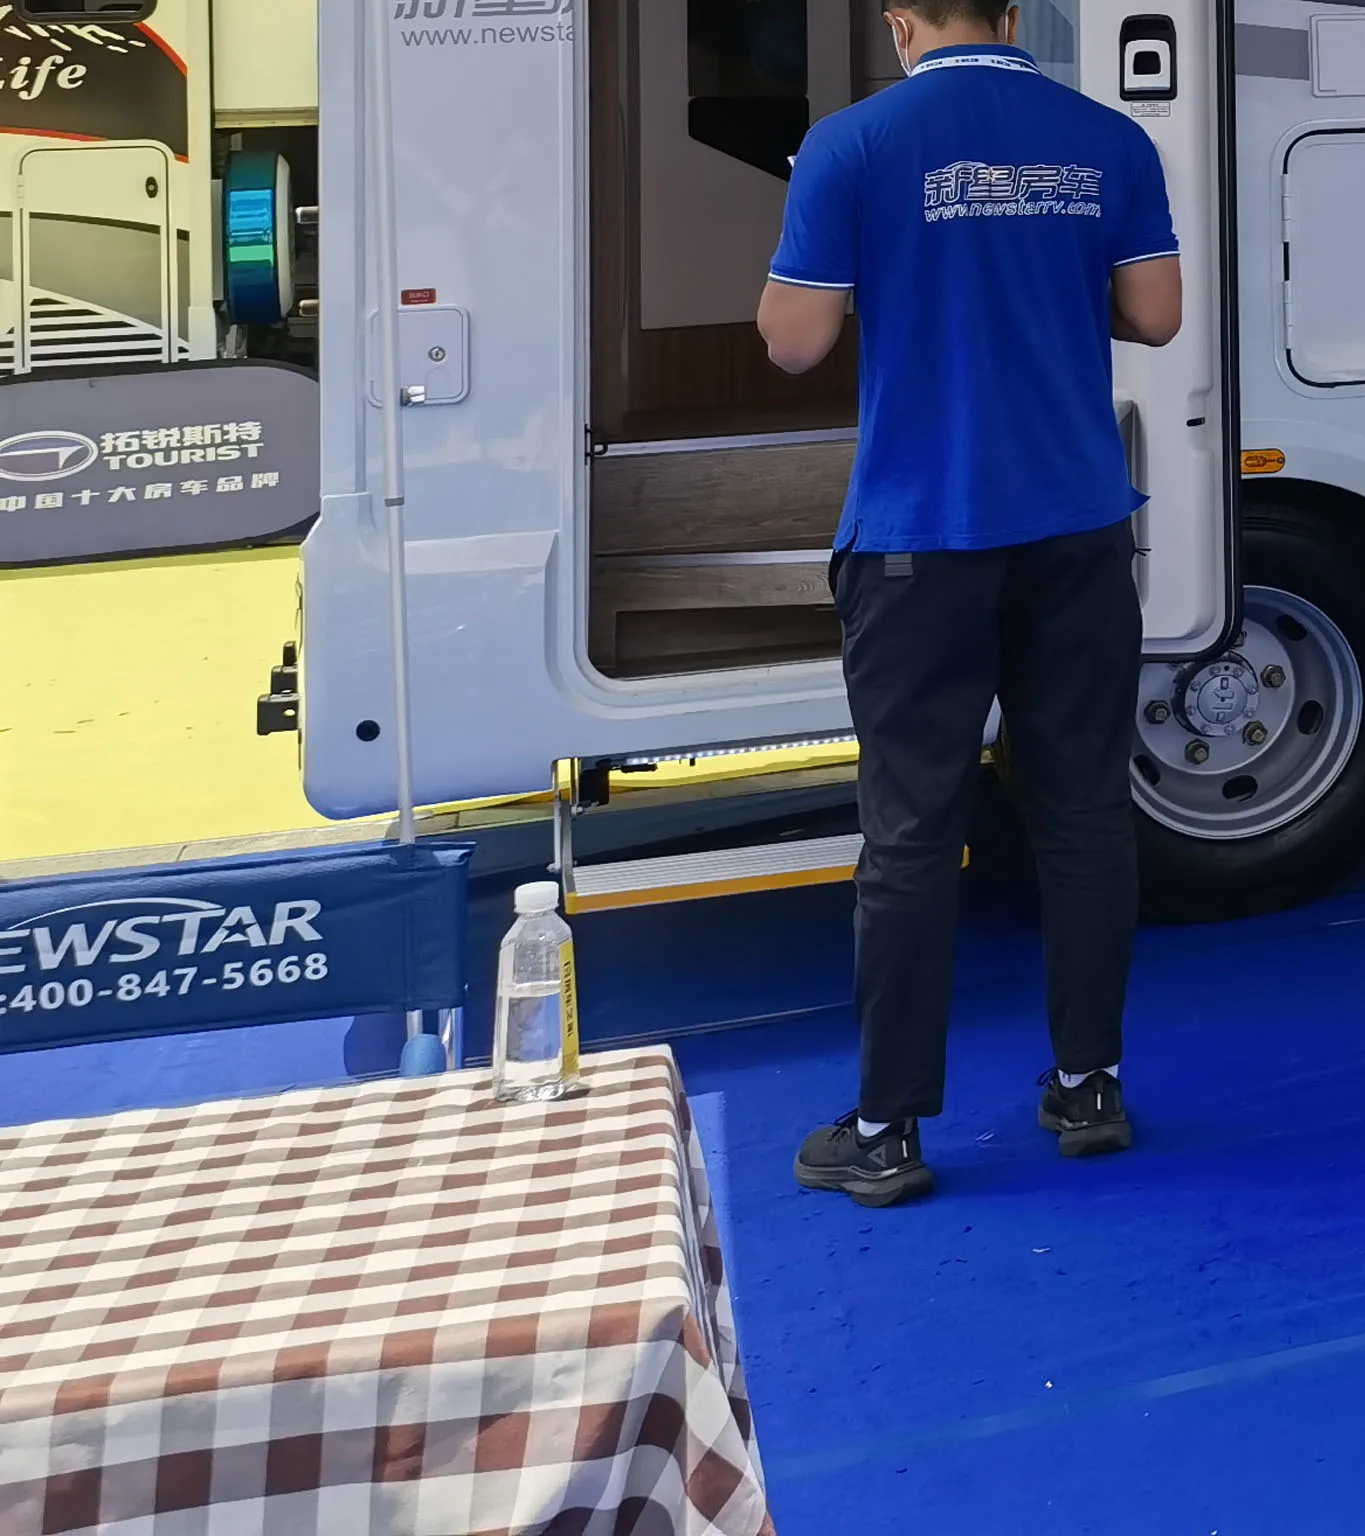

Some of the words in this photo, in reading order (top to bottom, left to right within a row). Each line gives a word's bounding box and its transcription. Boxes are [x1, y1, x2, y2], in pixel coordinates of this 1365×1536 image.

[0, 54, 87, 101] ife
[924, 161, 1103, 207] 新星房车
[101, 420, 262, 453] 拓锐斯特
[103, 443, 264, 470] TOURIST
